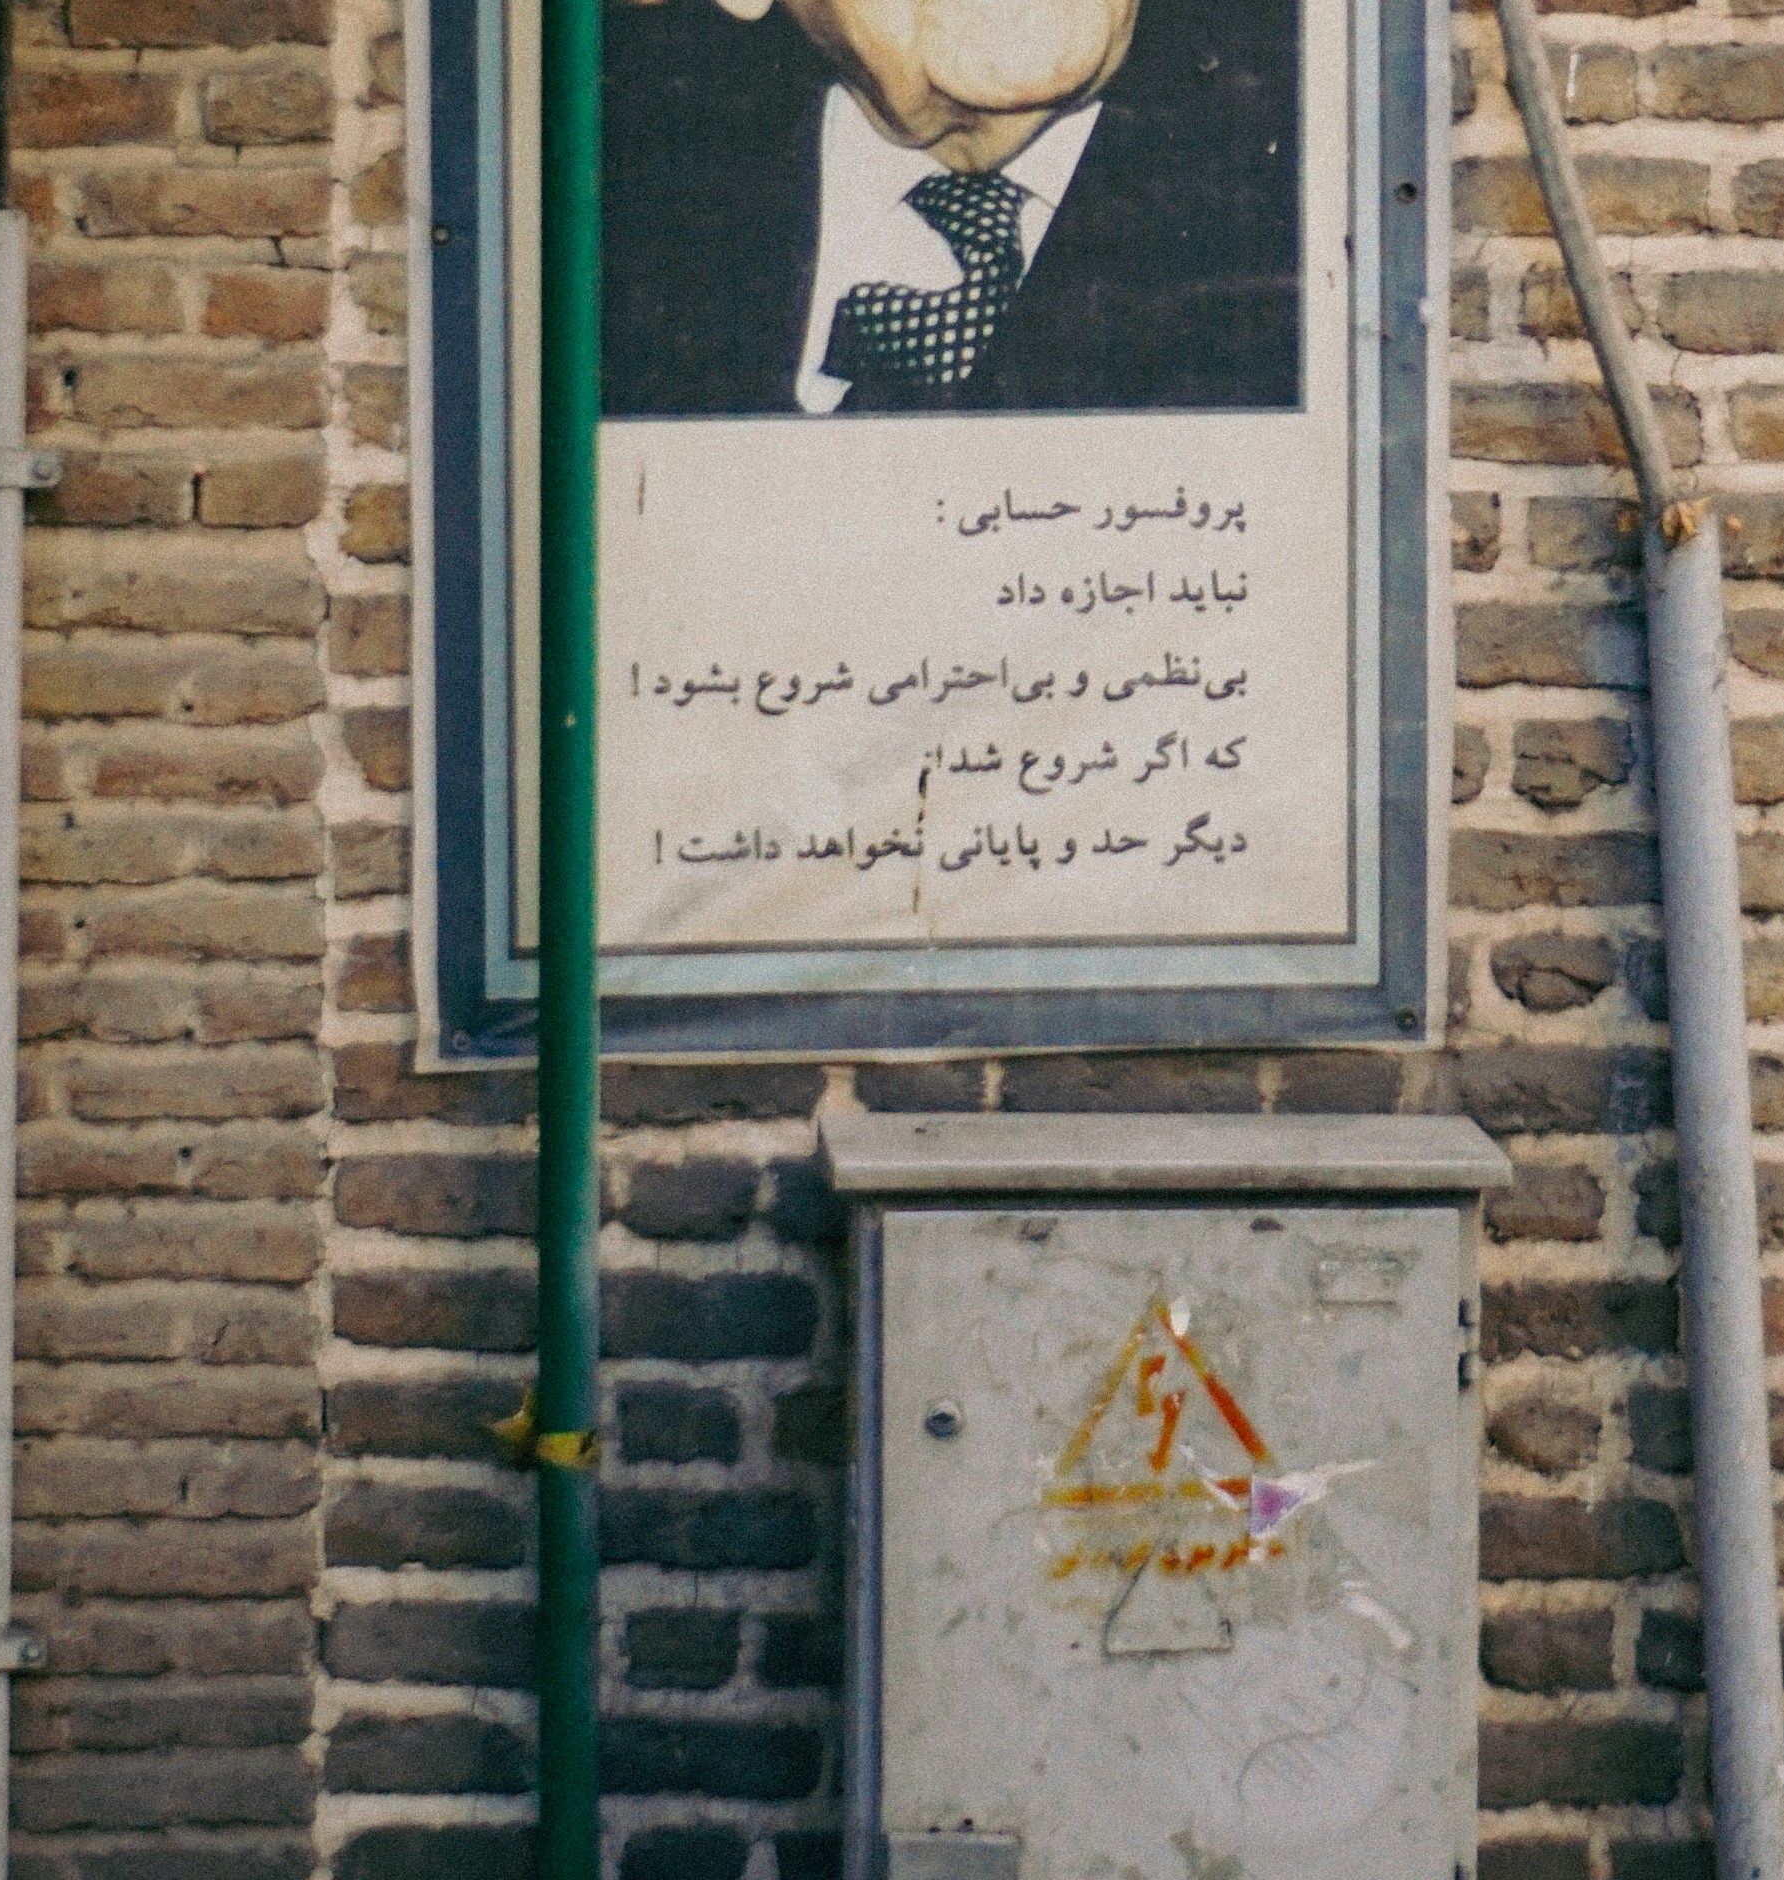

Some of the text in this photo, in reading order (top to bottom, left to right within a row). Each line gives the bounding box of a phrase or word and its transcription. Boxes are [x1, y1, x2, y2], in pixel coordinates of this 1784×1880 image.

[1093, 485, 1247, 533] پروفسور
[996, 569, 1249, 616] نباید اجازه داد
[753, 660, 855, 718] شروع
[1067, 669, 1090, 700] و
[1017, 740, 1119, 797] شروع
[1132, 730, 1189, 786] اگر
[1203, 735, 1249, 772] که
[796, 824, 925, 872] نخواهد
[938, 821, 1043, 873] پایانی
[1055, 835, 1079, 867] و
[1091, 827, 1150, 856] حد
[1162, 812, 1249, 868] دیگر
